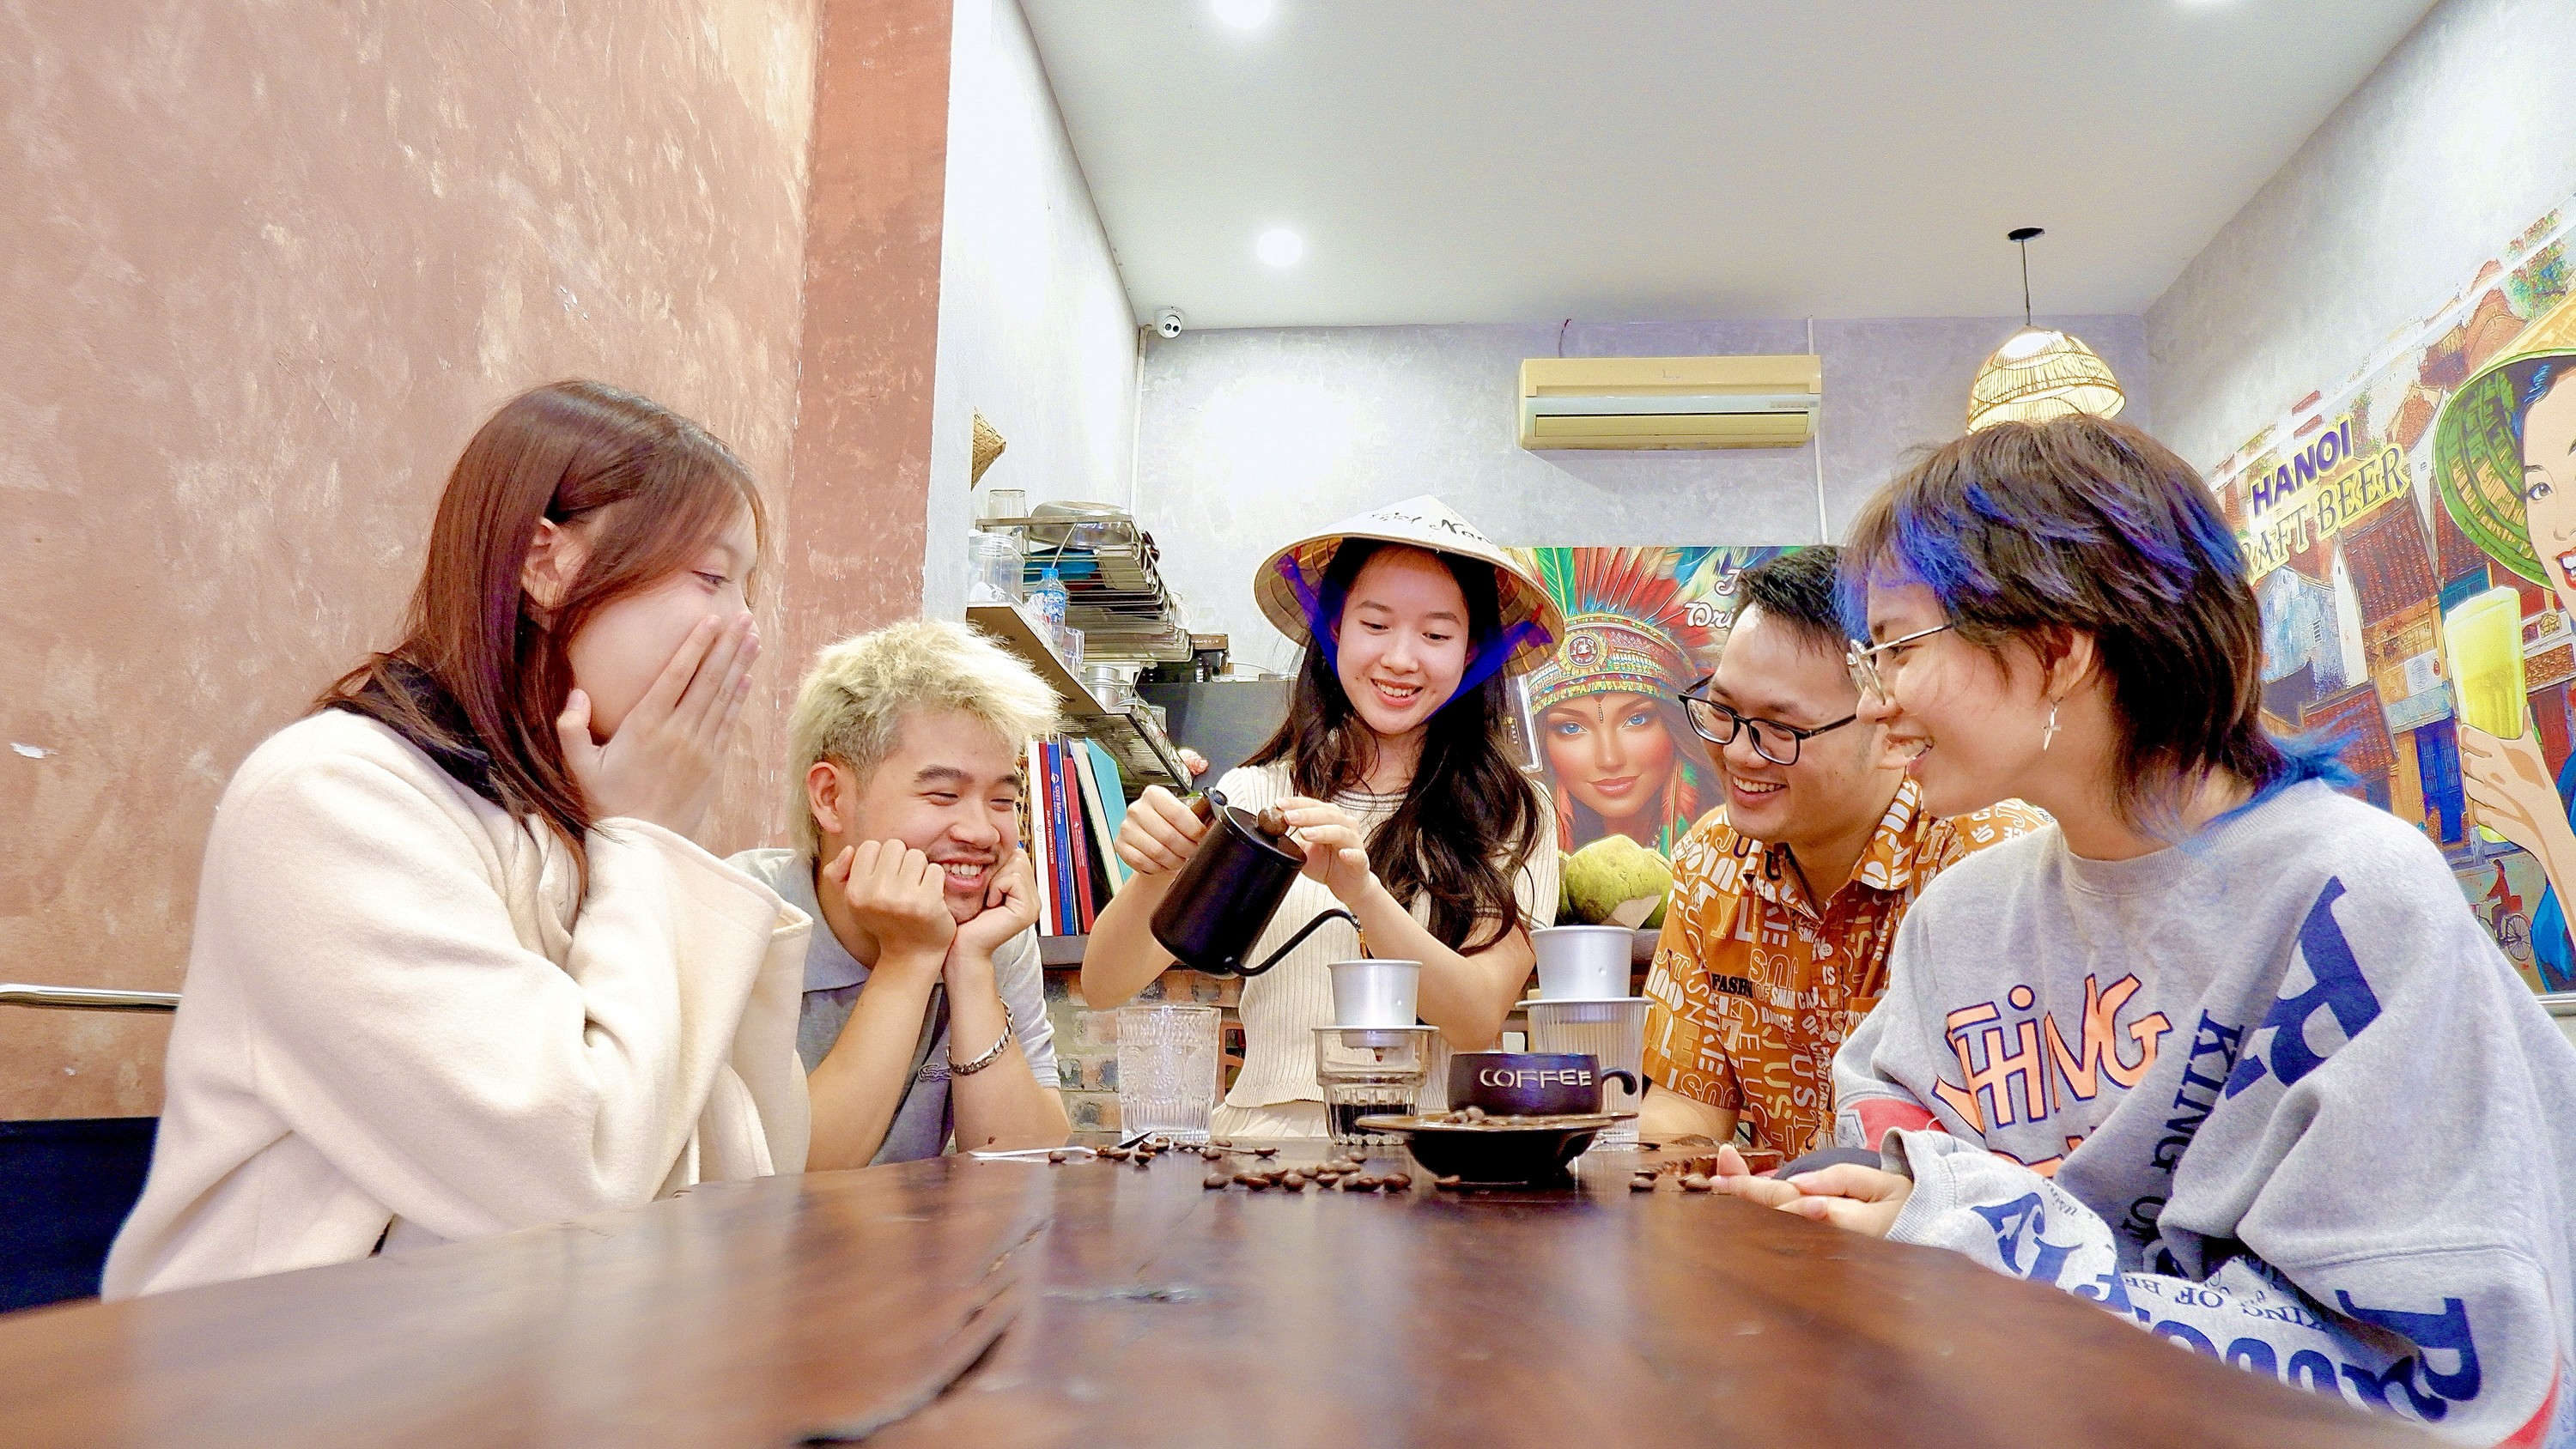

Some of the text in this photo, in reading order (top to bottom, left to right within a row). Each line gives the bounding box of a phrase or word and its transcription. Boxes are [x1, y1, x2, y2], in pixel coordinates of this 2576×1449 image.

[2251, 419, 2353, 516] HANOI
[2318, 447, 2406, 536] BEER
[1479, 1069, 1593, 1088] COFFEE
